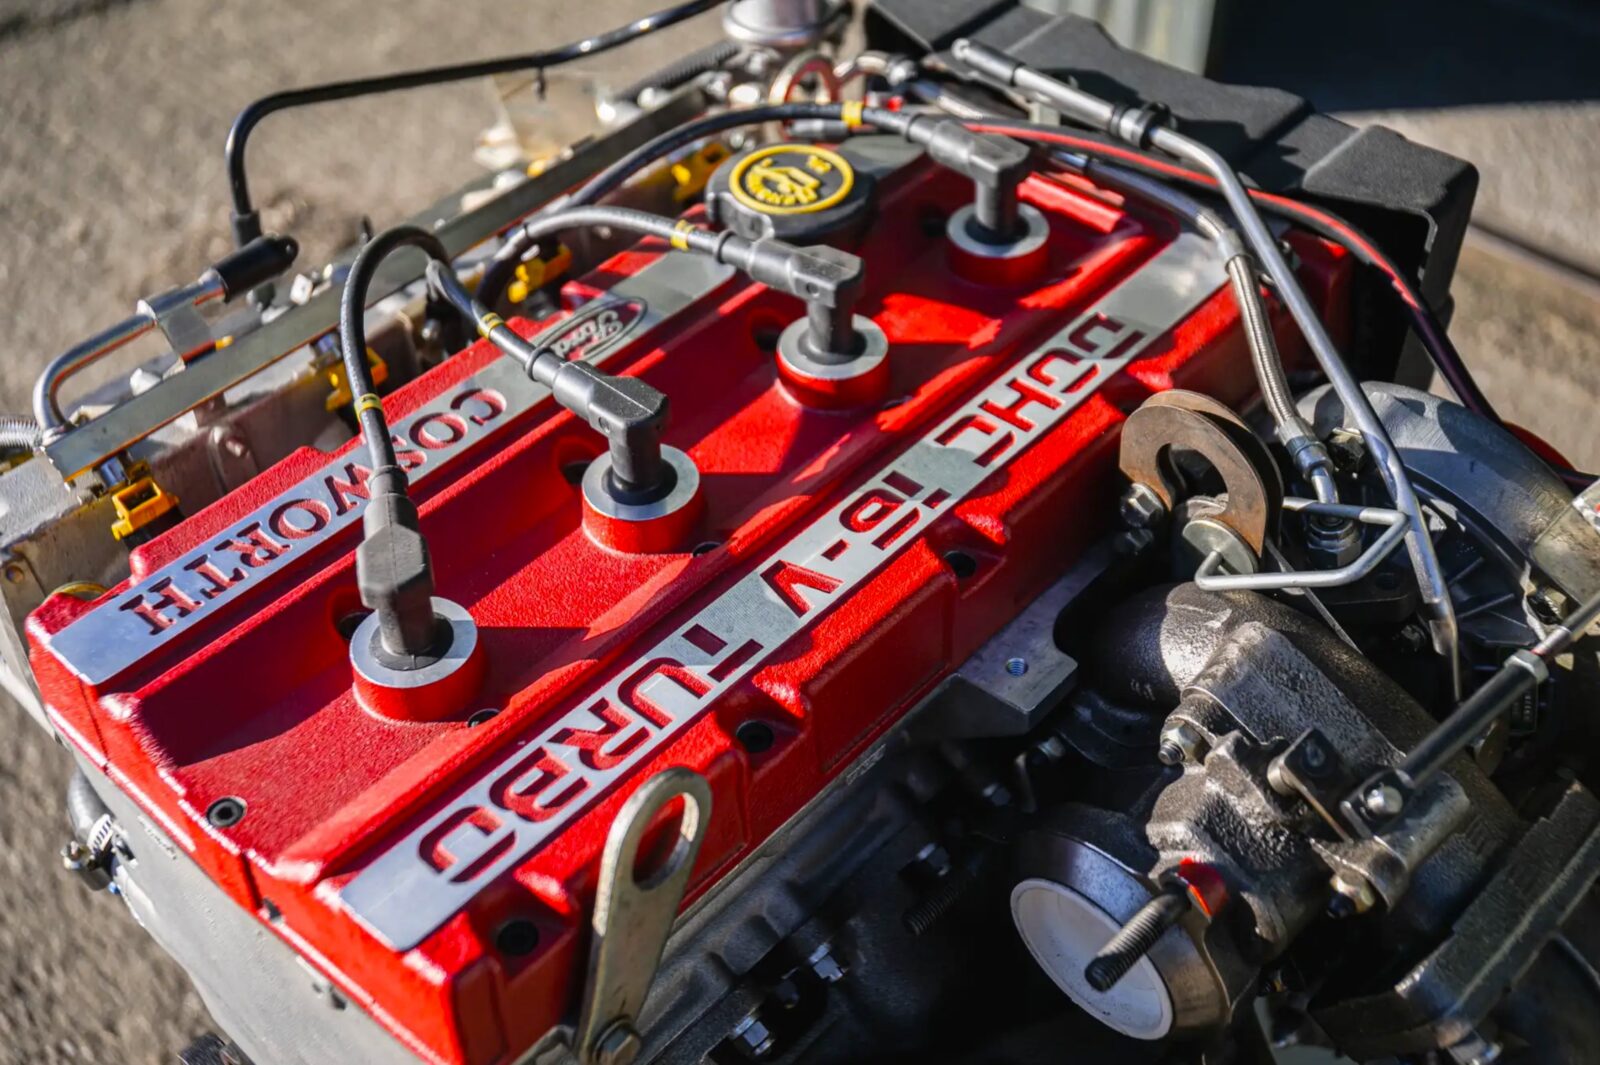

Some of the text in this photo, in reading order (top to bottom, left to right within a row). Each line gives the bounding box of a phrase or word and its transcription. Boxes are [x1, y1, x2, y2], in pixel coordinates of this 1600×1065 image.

[549, 310, 623, 360] Ford
[419, 311, 1148, 883] DOHC 16-V TURBO
